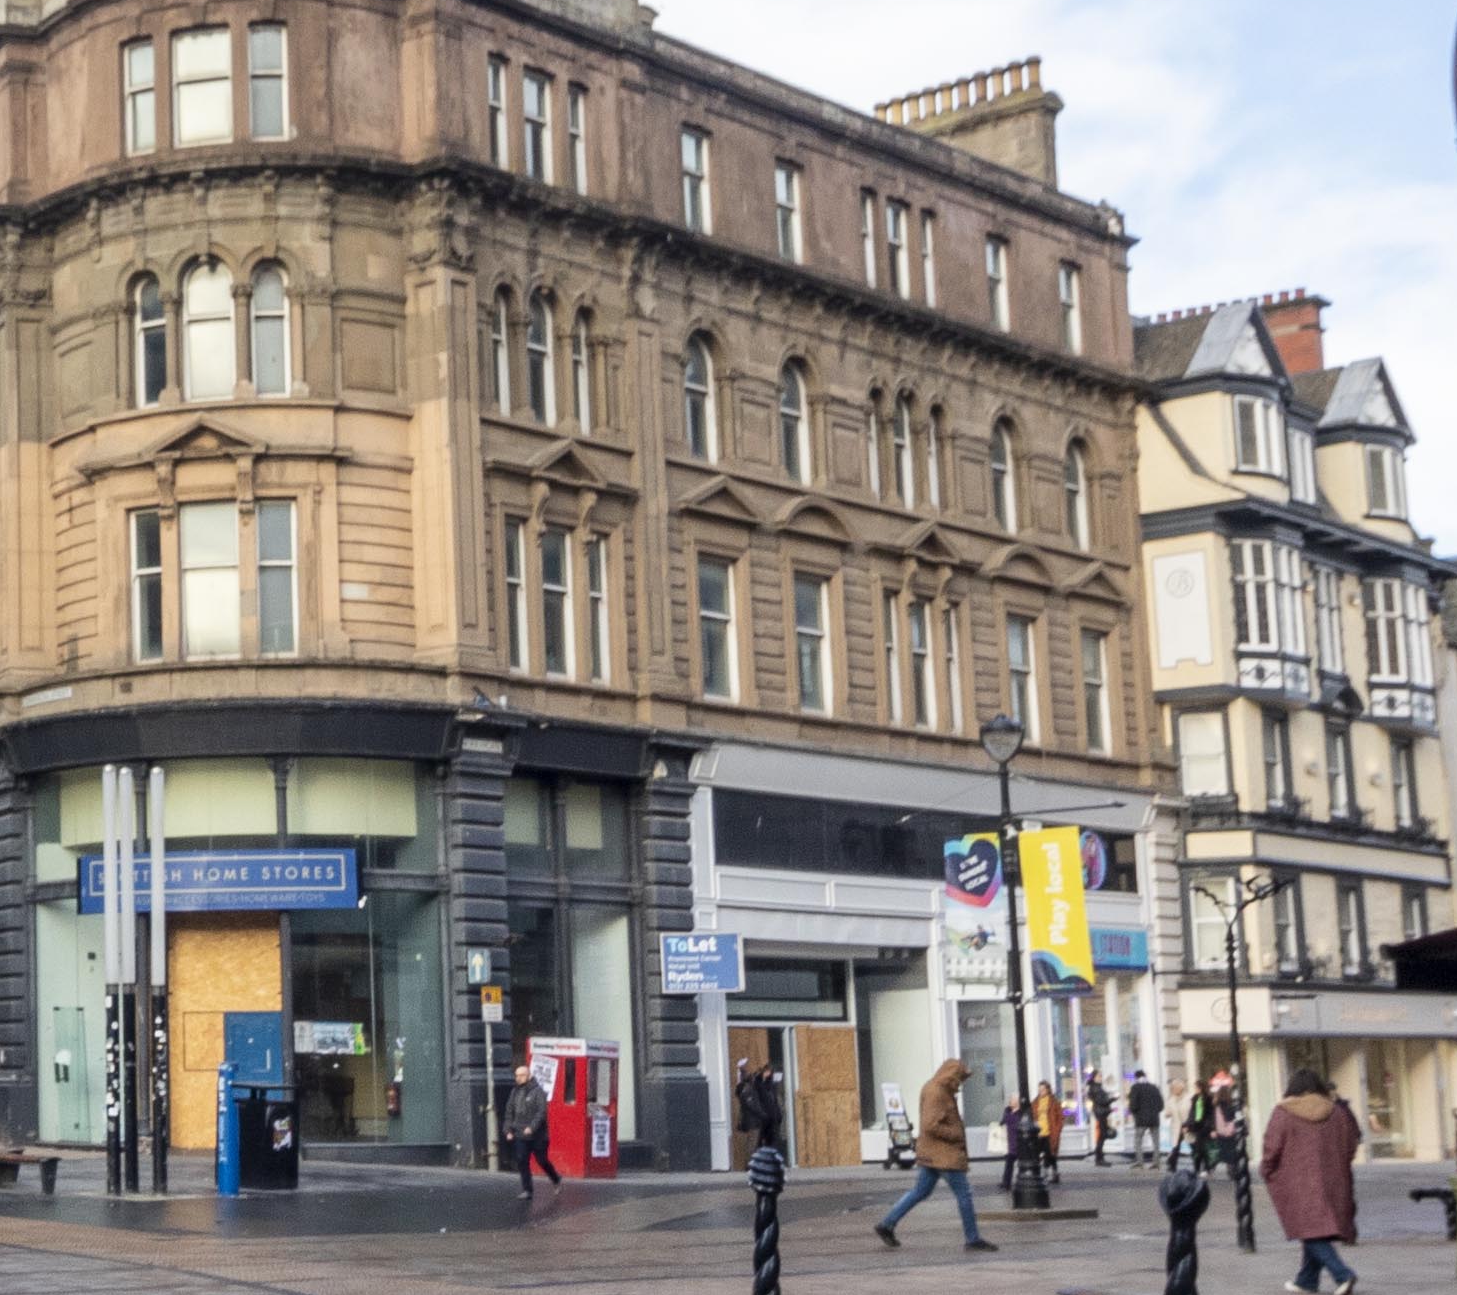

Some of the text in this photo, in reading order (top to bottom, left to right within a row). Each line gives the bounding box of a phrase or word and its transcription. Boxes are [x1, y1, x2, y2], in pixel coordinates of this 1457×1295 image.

[193, 866, 250, 882] HOME
[260, 865, 335, 881] STORES
[1040, 841, 1071, 946] Play local
